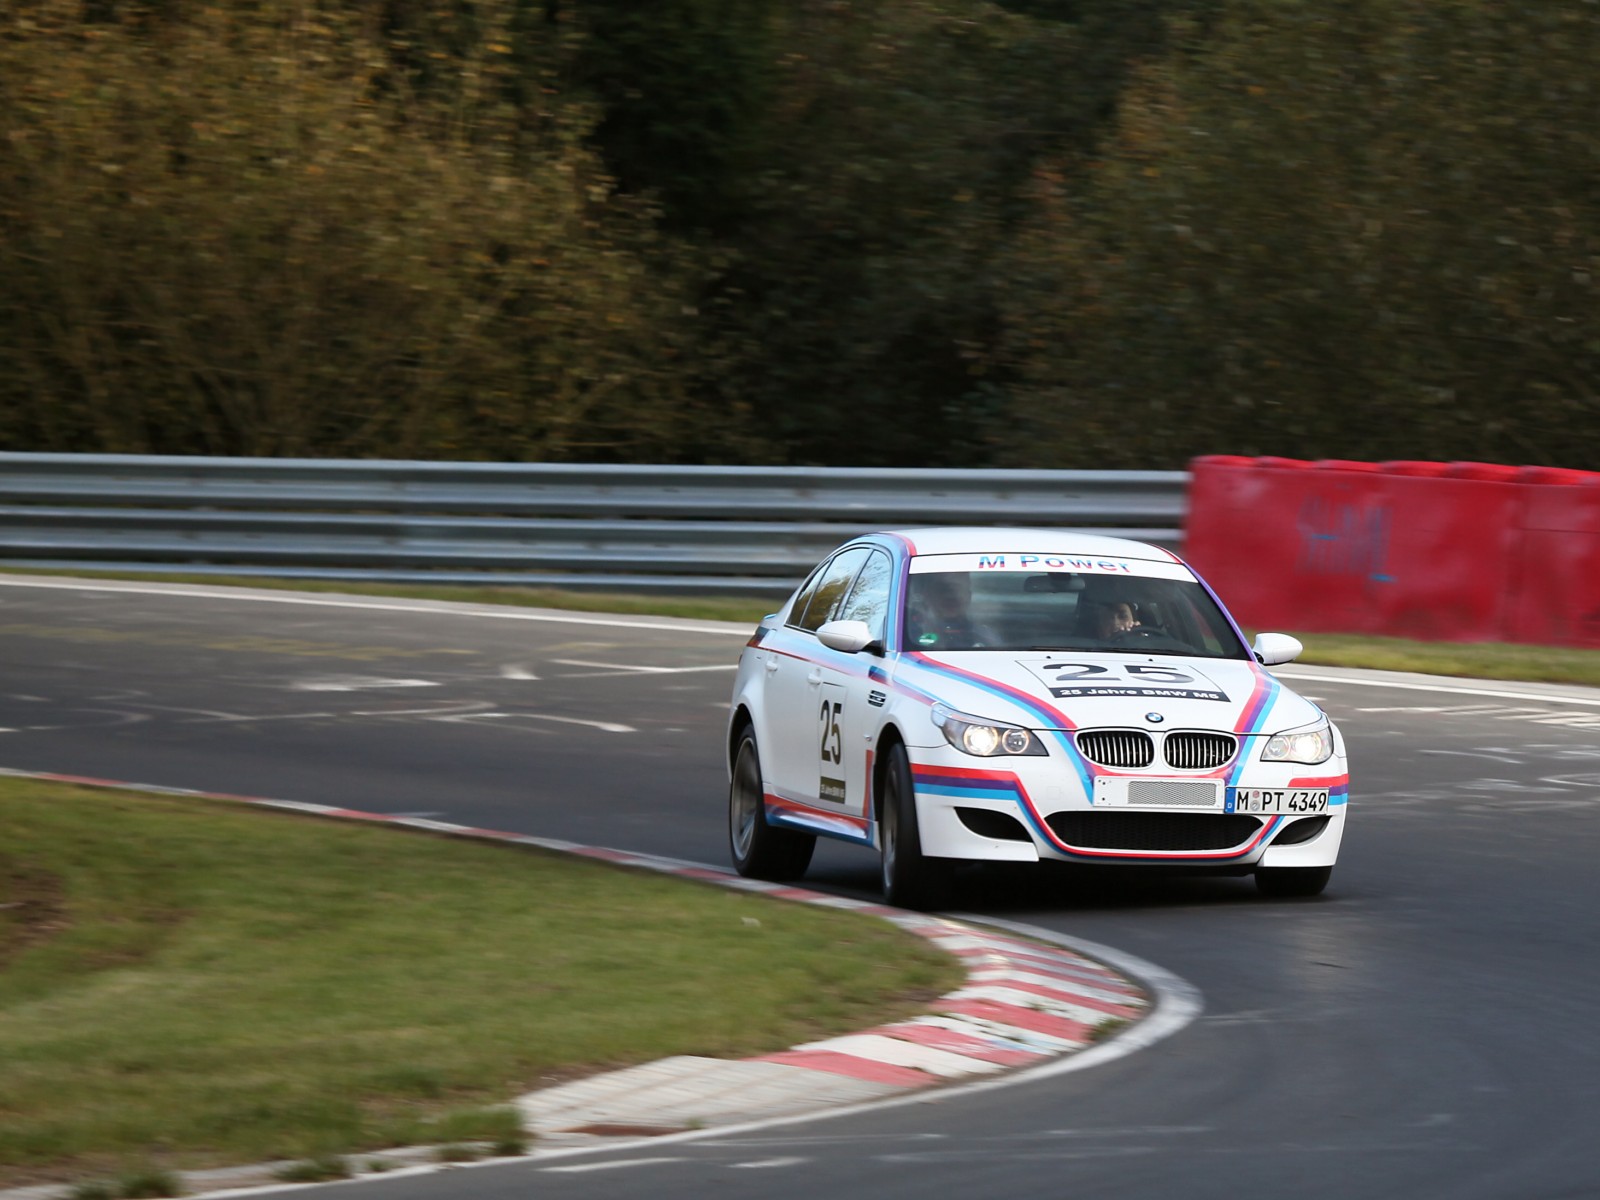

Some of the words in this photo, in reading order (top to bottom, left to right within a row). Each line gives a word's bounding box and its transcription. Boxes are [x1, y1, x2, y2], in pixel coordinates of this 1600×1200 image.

[978, 555, 1005, 569] M
[1020, 555, 1131, 573] Power
[1043, 663, 1195, 684] 25
[1060, 688, 1082, 696] 25
[1087, 688, 1137, 696] Jahre
[1141, 689, 1187, 697] BMW
[1193, 691, 1219, 700] M5
[820, 699, 842, 765] 25
[1236, 791, 1249, 811] M
[1261, 791, 1284, 812] PT
[1288, 792, 1327, 812] 4349
